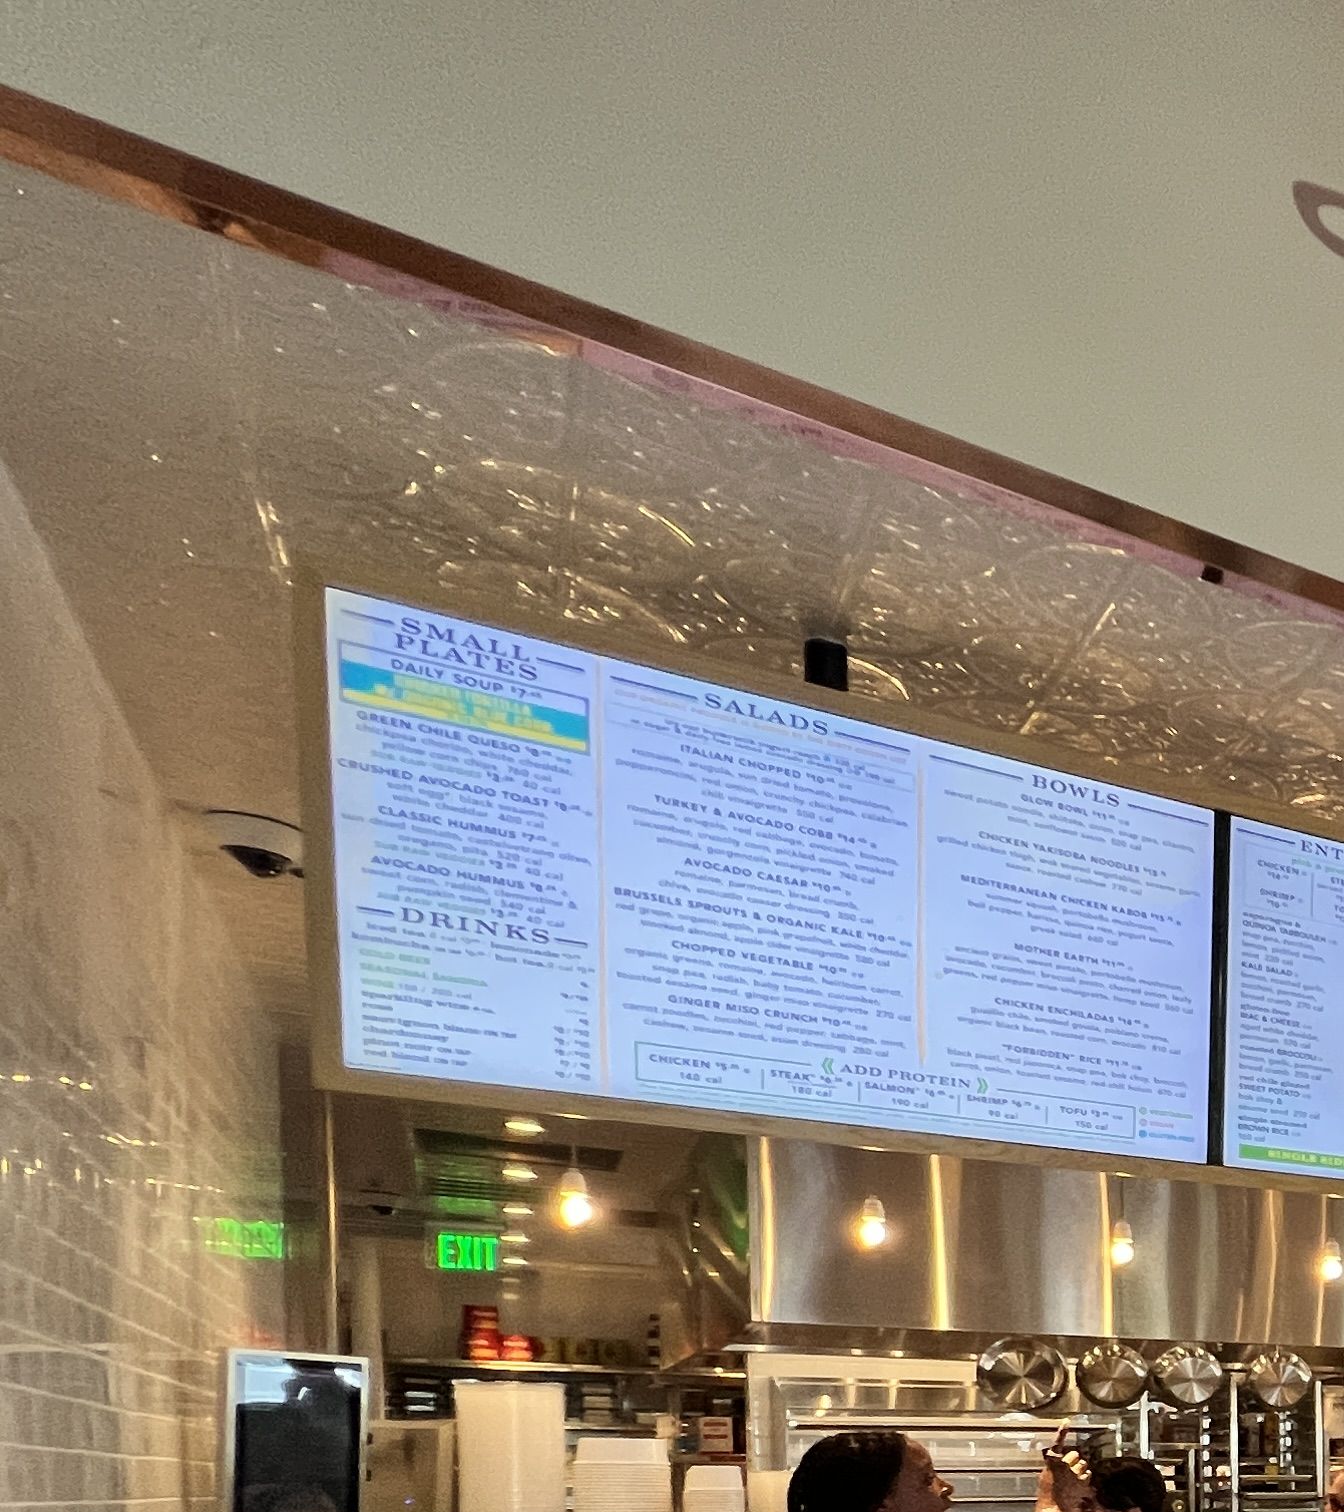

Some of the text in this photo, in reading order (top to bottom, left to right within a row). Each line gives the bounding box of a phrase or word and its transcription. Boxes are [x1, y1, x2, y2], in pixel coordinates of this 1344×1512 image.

[392, 631, 538, 683] PLATES
[400, 616, 530, 663] SMALL
[391, 657, 503, 694] DAILY SOUP
[356, 709, 520, 754] GREEN CHILE QUESO
[703, 692, 830, 737] SALADS
[680, 742, 733, 765] ITALIAN
[738, 756, 801, 780] CHOPPED
[336, 756, 549, 809] CRUSHED AVOCADO TOAST
[1031, 773, 1120, 808] BOWLS
[377, 804, 516, 840] CLASSIC HUMMUS
[654, 793, 707, 814] TURKEY
[713, 806, 721, 817] &
[727, 809, 794, 832] AVOCADO
[1057, 801, 1087, 816] BOWL
[978, 829, 1139, 873] CHICKEN YAKISOBA NOODLES
[370, 854, 524, 890] AVOCADO HUMMUS
[683, 855, 807, 889] AVOCADO CAESAR
[614, 885, 862, 939] BRUSSELS SPROUTS & ORGANIC KALE
[960, 873, 1147, 920] MEDITERRANEAN CHICKEN KABOB
[400, 906, 550, 945] DRINKS
[672, 939, 813, 971] CHOPPED VEGETABLE
[1014, 942, 1098, 965] MOTHER EARTH
[668, 993, 818, 1024] GINGER MISO CRUNCH
[994, 996, 1114, 1023] CHICKEN ENCHILADAS
[649, 1053, 710, 1070] CHICKEN
[839, 1061, 970, 1089] ADD PROTEIN
[1079, 1054, 1101, 1065] RICE
[705, 1074, 721, 1084] cal
[816, 1088, 832, 1098] cal
[914, 1100, 928, 1110] cal
[1004, 1111, 1018, 1120] cal
[1059, 1105, 1087, 1117] TOFU
[1094, 1122, 1108, 1131] cal
[438, 1234, 496, 1270] EXIT
